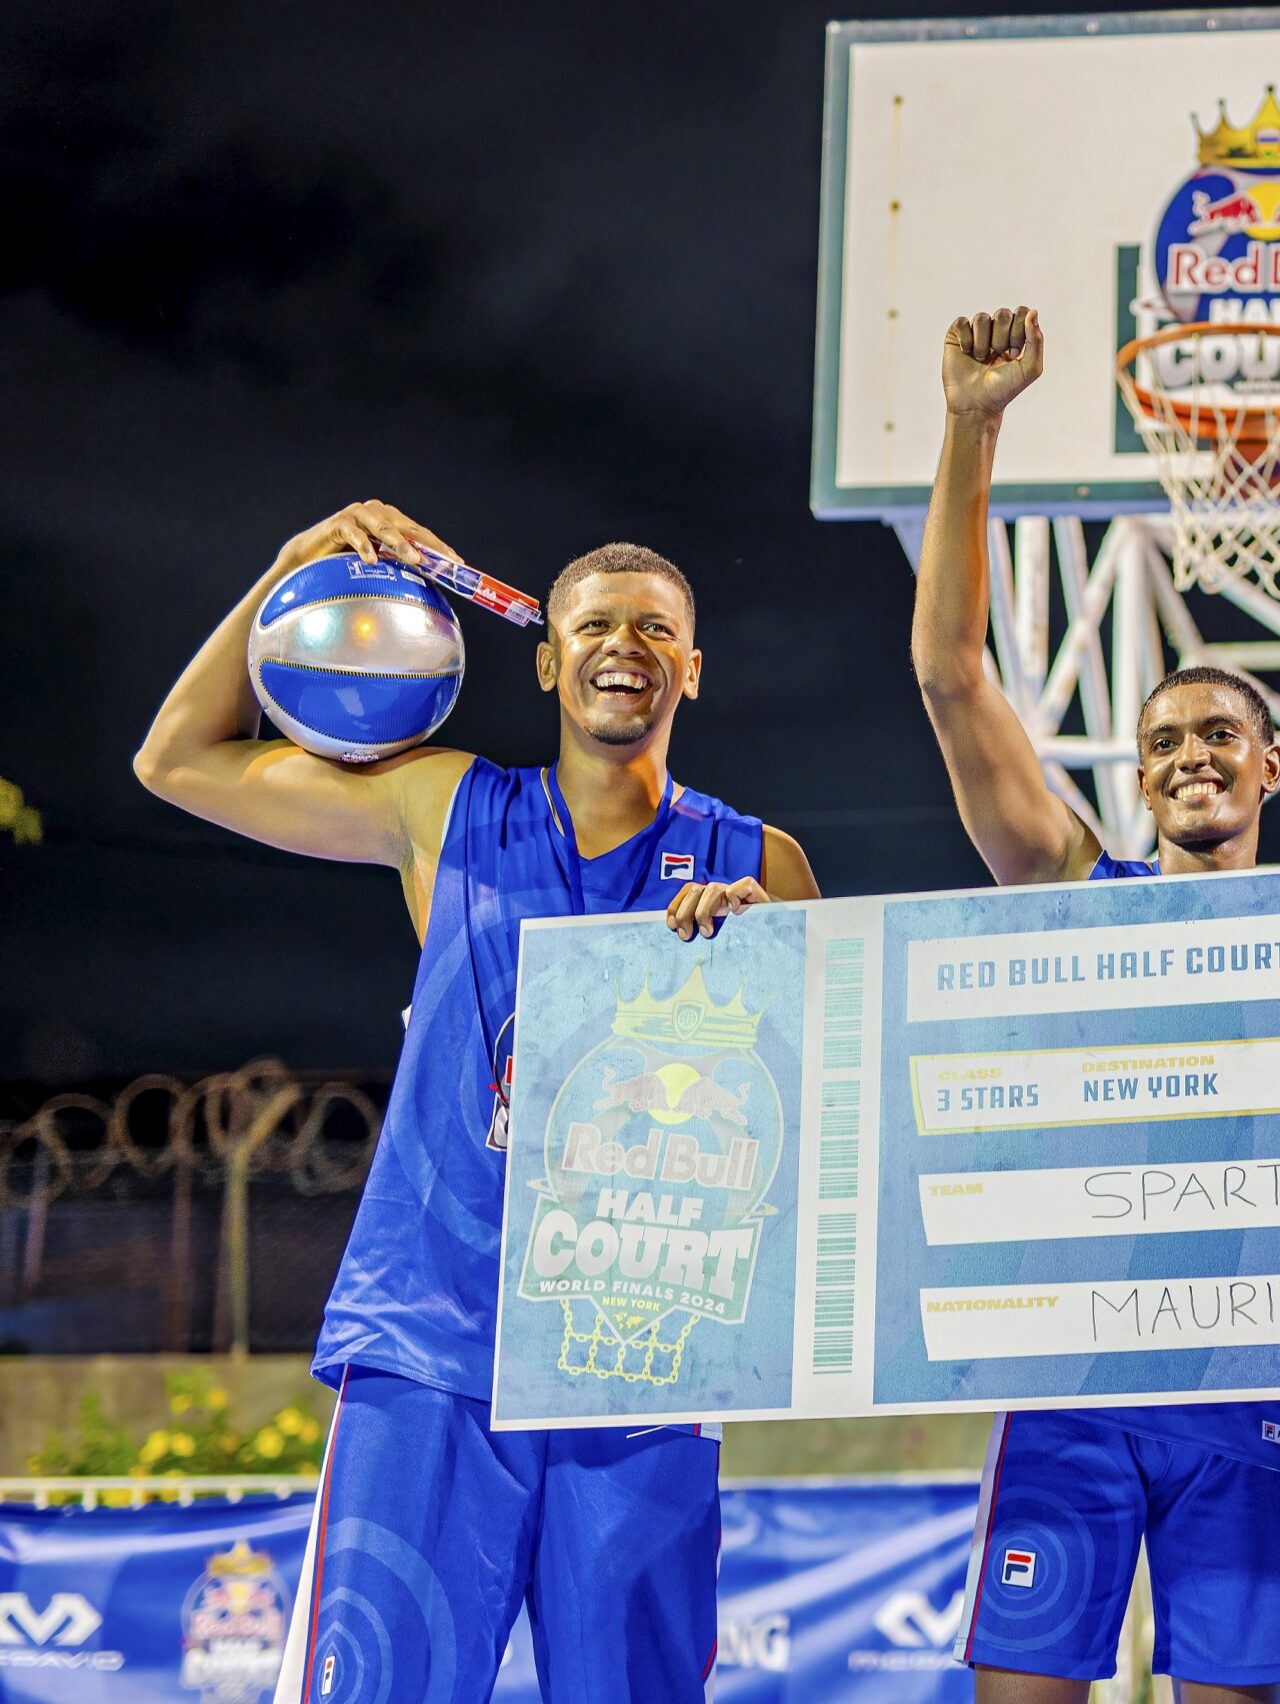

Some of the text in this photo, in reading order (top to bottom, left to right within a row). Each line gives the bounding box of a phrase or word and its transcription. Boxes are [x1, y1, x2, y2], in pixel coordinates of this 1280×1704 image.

[1172, 246, 1261, 287] Red
[936, 961, 997, 991] RED
[1008, 955, 1086, 987] BULL
[1096, 949, 1175, 981] HALF
[938, 1067, 1004, 1081] CLASS
[1081, 1054, 1215, 1073] DESTINATION
[936, 1088, 950, 1112] 3
[960, 1083, 1040, 1111] STARS
[1082, 1077, 1139, 1103] NEW
[1147, 1072, 1219, 1099] YORK
[560, 1121, 664, 1180] Red
[659, 1132, 760, 1191] Bull
[595, 1187, 704, 1227] HALF
[928, 1183, 984, 1196] TEAM
[532, 1208, 754, 1300] COURT
[538, 1279, 726, 1316] WORLD FINALS 2024
[602, 1296, 661, 1312] NEW YORK
[926, 1295, 1060, 1313] NATIONALITY
